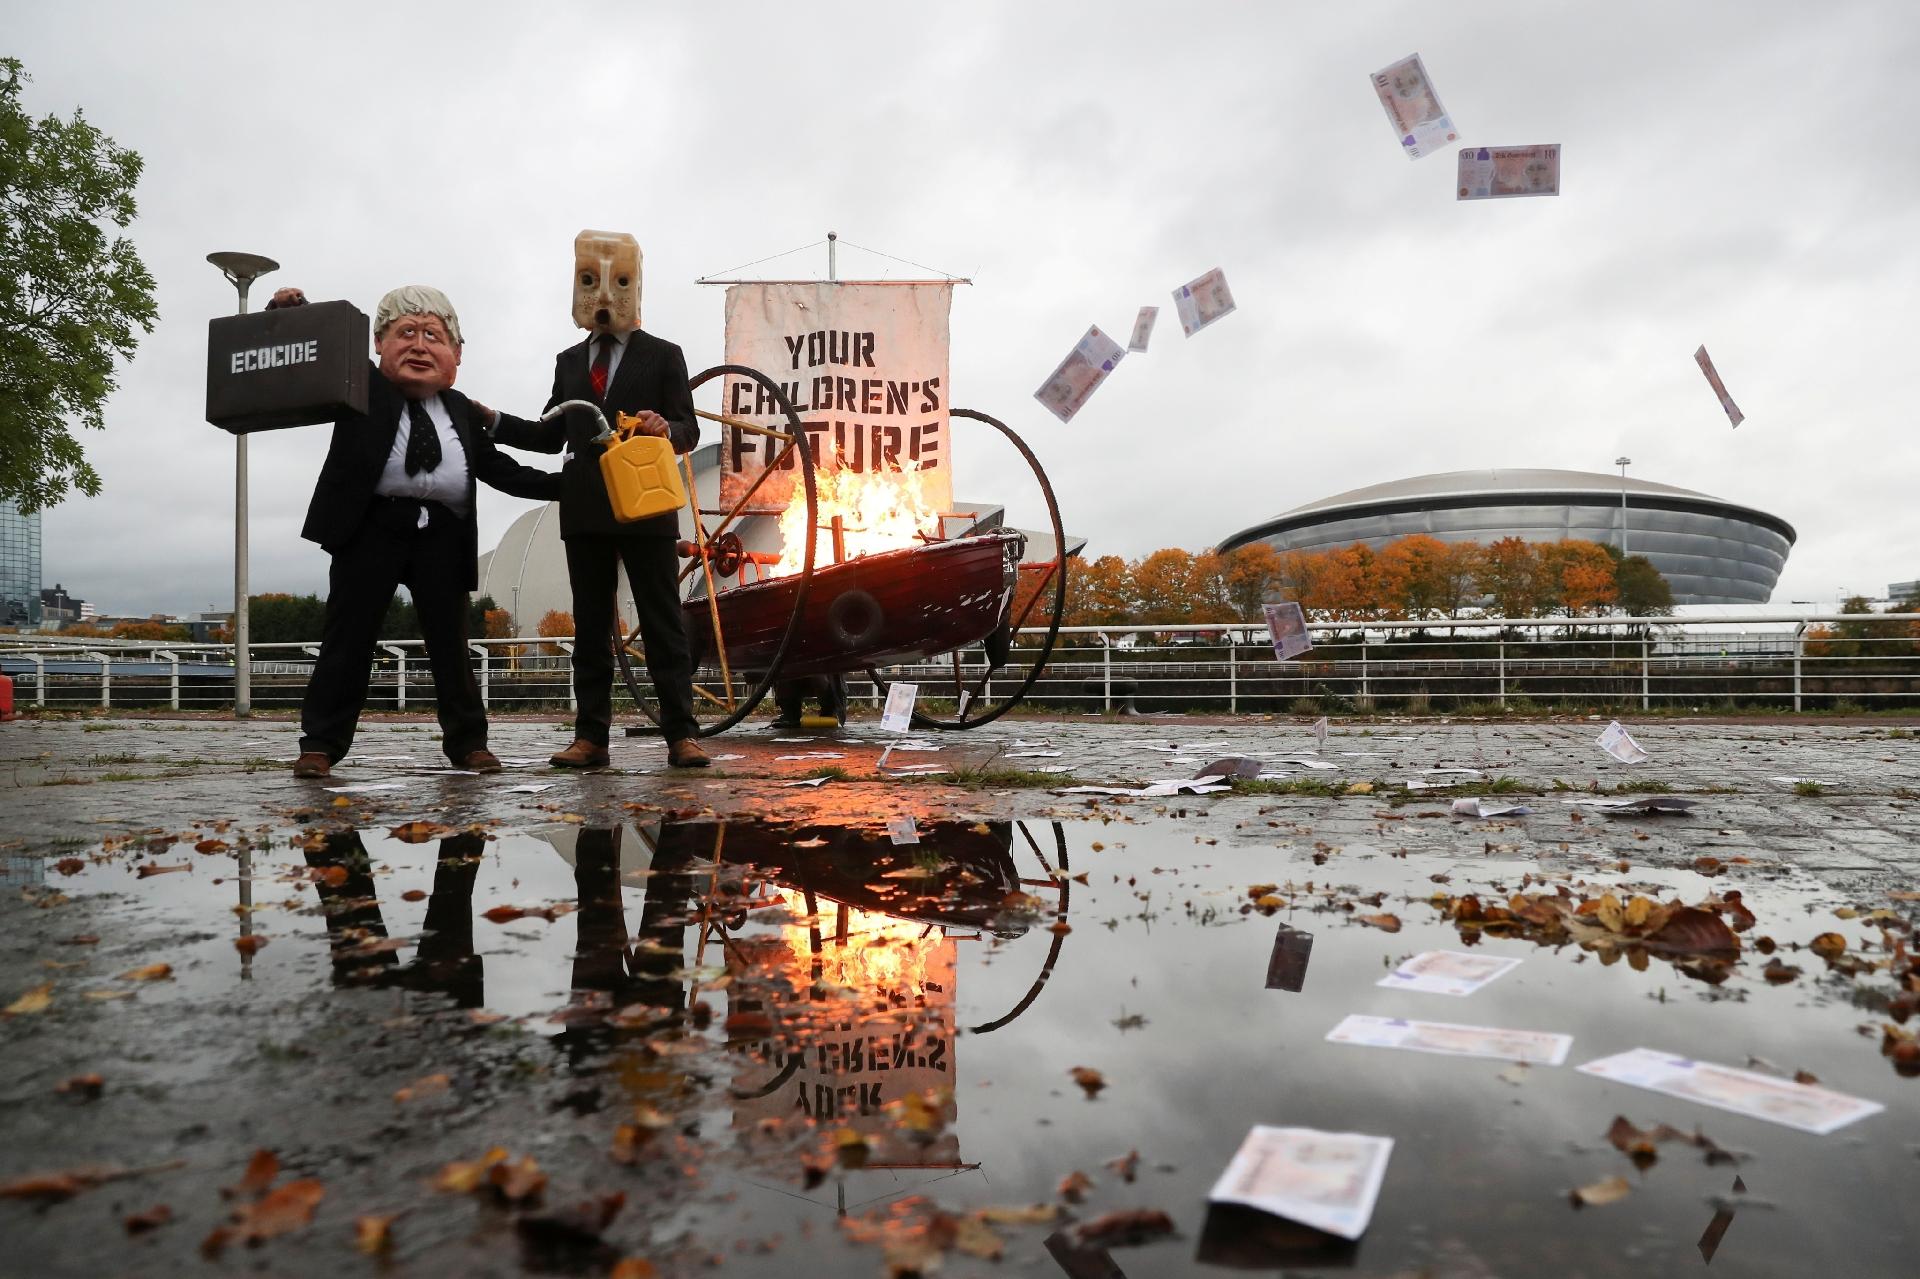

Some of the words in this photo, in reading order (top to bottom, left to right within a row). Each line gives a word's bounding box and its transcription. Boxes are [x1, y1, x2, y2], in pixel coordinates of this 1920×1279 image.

[231, 340, 317, 373] ECOCIDE
[784, 330, 875, 370] YOUR
[731, 421, 939, 473] FUTURE
